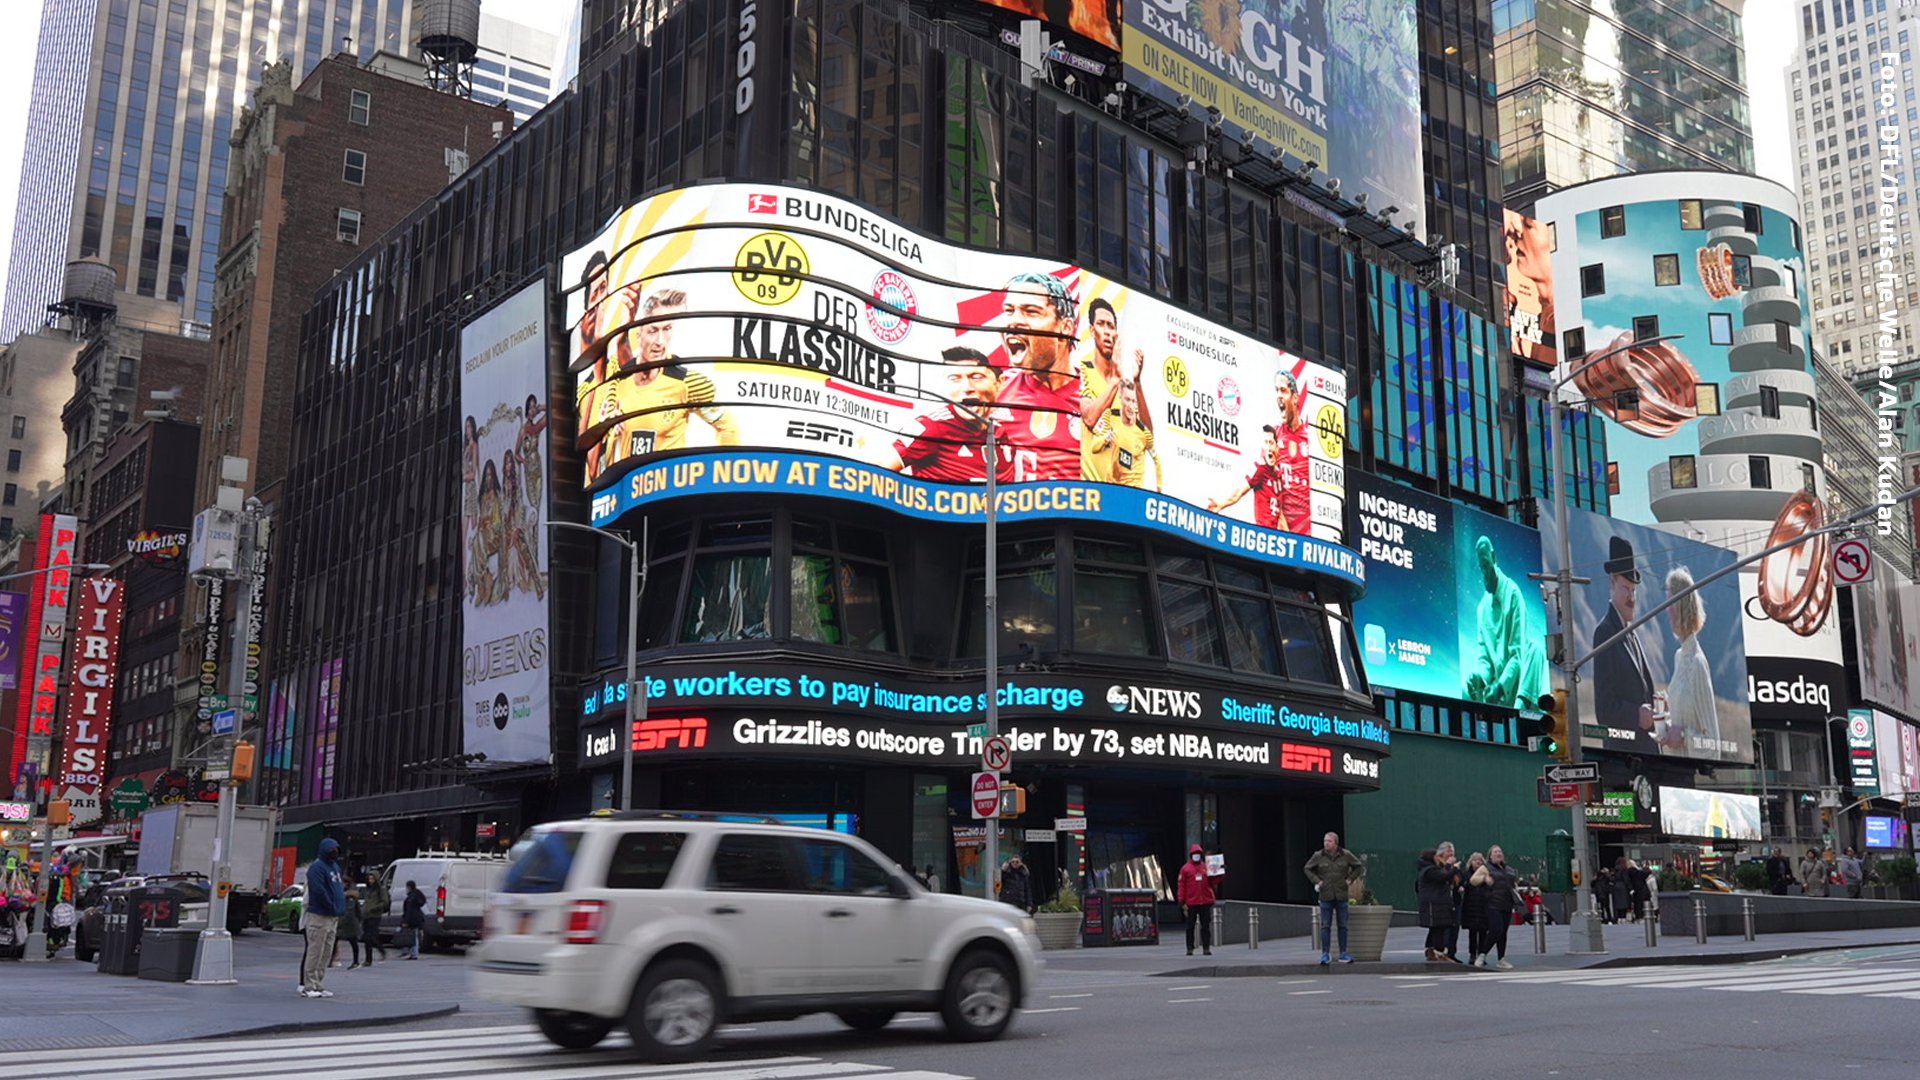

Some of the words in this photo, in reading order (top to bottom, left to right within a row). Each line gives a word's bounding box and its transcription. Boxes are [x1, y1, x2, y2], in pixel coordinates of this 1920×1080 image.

[736, 0, 756, 114] 500
[1142, 2, 1225, 71] Exhibit
[1229, 55, 1276, 100] New
[1280, 83, 1328, 131] York
[1142, 43, 1159, 67] ON
[1162, 53, 1189, 90] SALE
[1192, 71, 1218, 105] NOW
[1232, 94, 1322, 163] VanGoghNYC.com
[785, 197, 923, 264] BUNDESLIGA
[757, 283, 777, 299] 09
[814, 290, 858, 335] DER
[492, 338, 509, 358] YOUR
[510, 321, 538, 348] THRONE
[733, 317, 896, 394] KLASSIKER
[1179, 335, 1238, 367] BUNDESLIGA
[737, 381, 820, 406] SATURDAY
[826, 394, 890, 425] 12:30PM/ET
[1192, 390, 1215, 414] DER
[1167, 401, 1239, 446] KLASSIKER
[631, 437, 652, 455] 1&1
[631, 467, 667, 498] SIGN
[674, 461, 705, 487] UP
[713, 459, 779, 484] NOW
[787, 461, 820, 486] AT
[1145, 498, 1227, 543] GERMANY'S
[1231, 526, 1298, 558] BIGGEST
[1359, 491, 1437, 532] INCREASE
[1359, 514, 1404, 544] YOUR
[127, 533, 187, 553] VIRGIL'S
[1361, 538, 1414, 569] PEACE
[48, 529, 75, 608] PARK
[464, 627, 548, 686] QUEENS
[1397, 639, 1432, 655] LEBRON
[1398, 653, 1427, 666] JAMES
[33, 655, 61, 734] PARK
[71, 580, 117, 773] VIRGILS
[617, 676, 666, 701] ste
[673, 671, 791, 697] workers
[799, 674, 825, 698] to
[832, 681, 870, 709] pay
[874, 682, 973, 713] insurance
[976, 682, 1084, 711] scharge
[210, 697, 257, 711] Broay
[475, 700, 490, 714] TUES
[1129, 685, 1202, 719] NEWS
[1222, 698, 1275, 726] Sheriff:
[1279, 705, 1332, 737] Georgia
[1333, 719, 1359, 739] teen
[1360, 718, 1382, 743] killed
[631, 717, 708, 751] ESPN
[733, 719, 850, 749] Grizzlies
[856, 728, 945, 756] outscore
[951, 727, 1047, 756] Thder
[1053, 727, 1085, 757] by
[1091, 729, 1125, 759] 73,
[1130, 735, 1165, 756] set
[1169, 734, 1213, 760] NBA
[1216, 743, 1269, 764] record
[1281, 743, 1332, 774] ESPN
[1343, 752, 1368, 777] Suns
[64, 773, 100, 785] BBQ
[1553, 770, 1569, 779] ONE
[1575, 768, 1591, 777] WAY
[977, 800, 994, 809] ENTER
[1585, 807, 1620, 816] OFFEE
